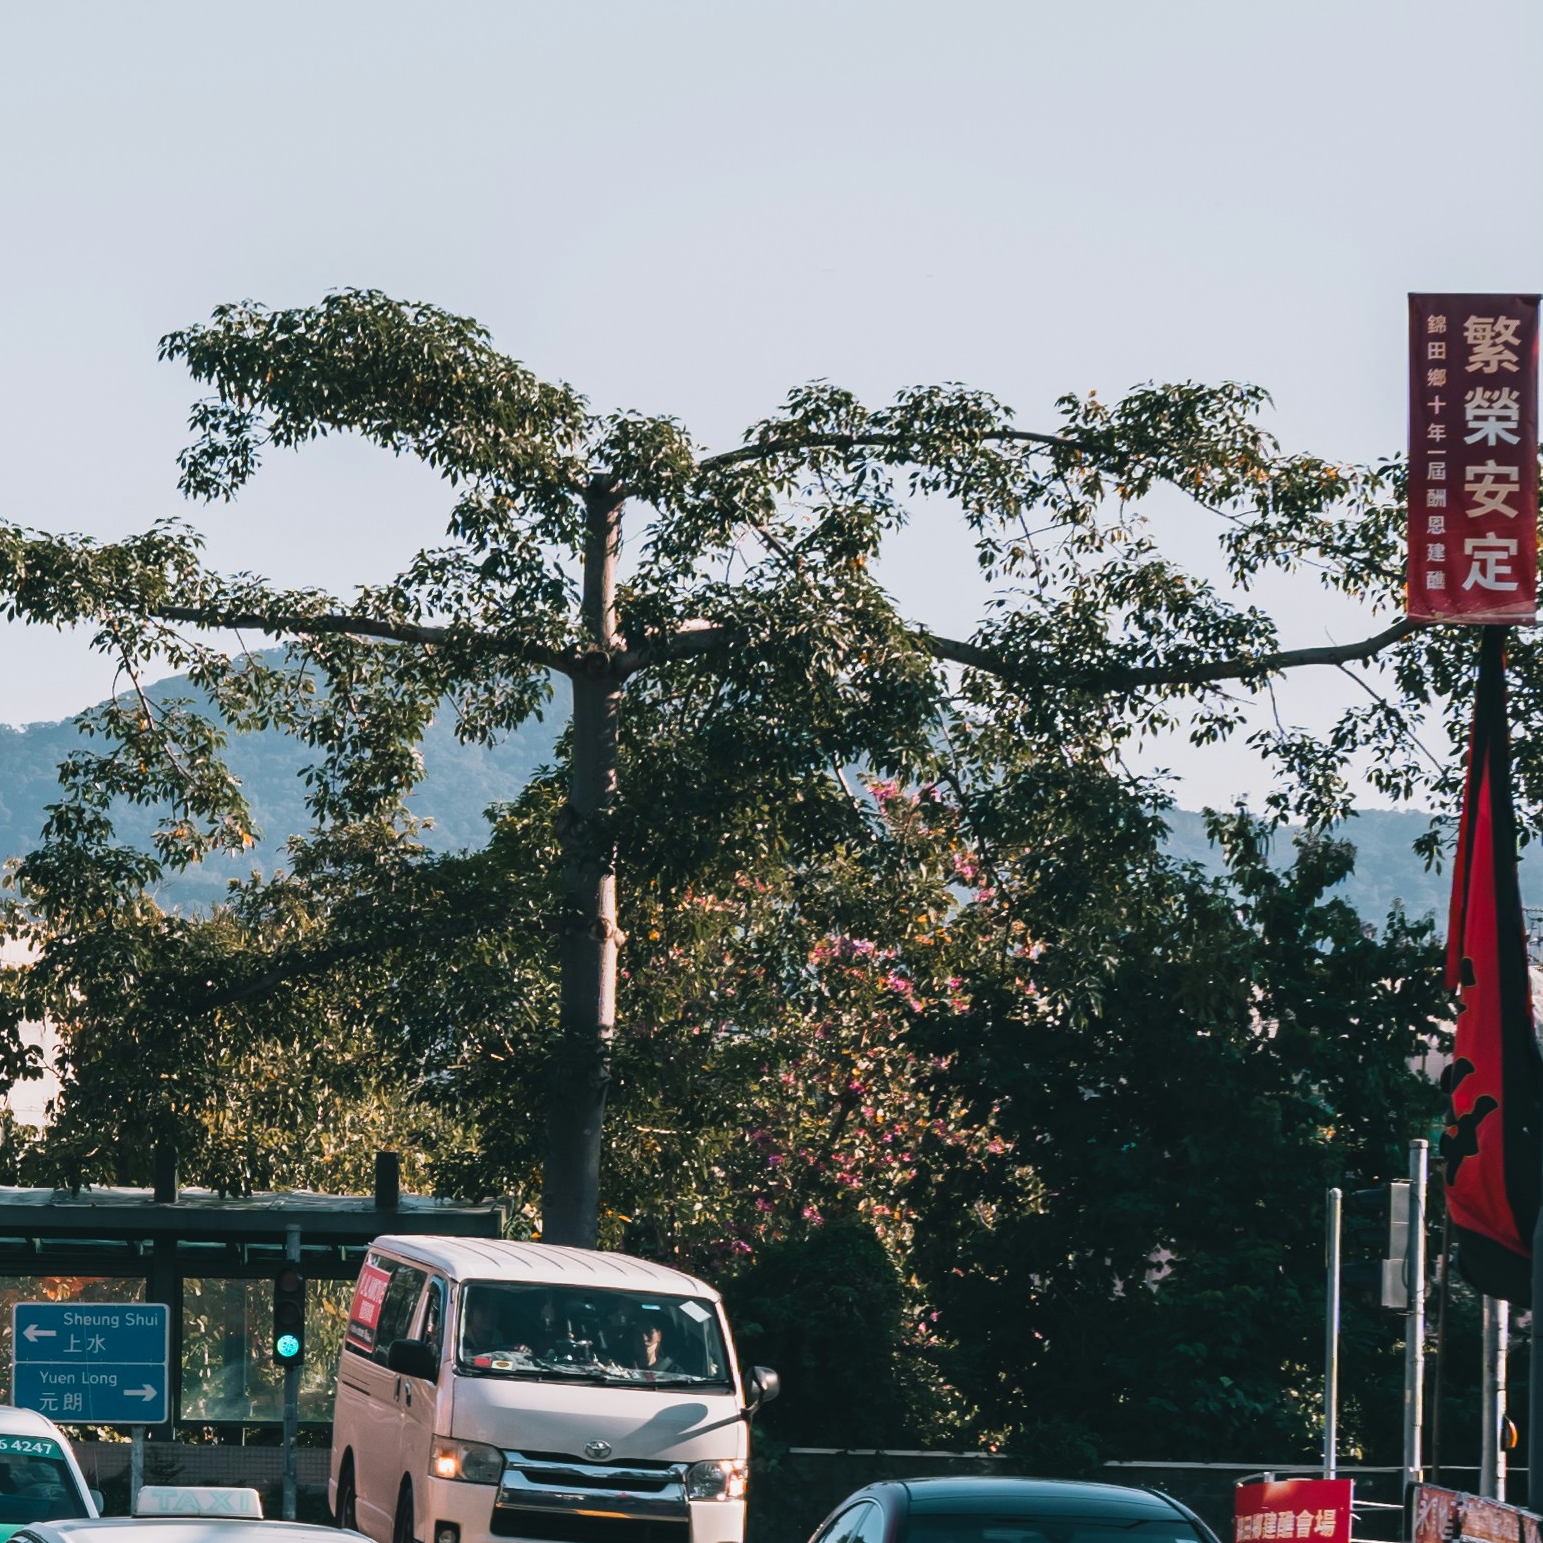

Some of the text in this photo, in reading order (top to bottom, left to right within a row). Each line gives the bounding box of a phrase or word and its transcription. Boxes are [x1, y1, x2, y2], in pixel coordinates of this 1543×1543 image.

[1426, 314, 1447, 590] 錦田鄉十年一屆酬恩建醮
[1462, 314, 1522, 592] 繁榮安定
[63, 1312, 158, 1328] Sheung Shui
[63, 1333, 106, 1353] 上水
[39, 1370, 117, 1386] Yuen Long
[39, 1392, 83, 1412] 元朗
[11, 1440, 51, 1455] 4247
[151, 1490, 250, 1513] TAXI
